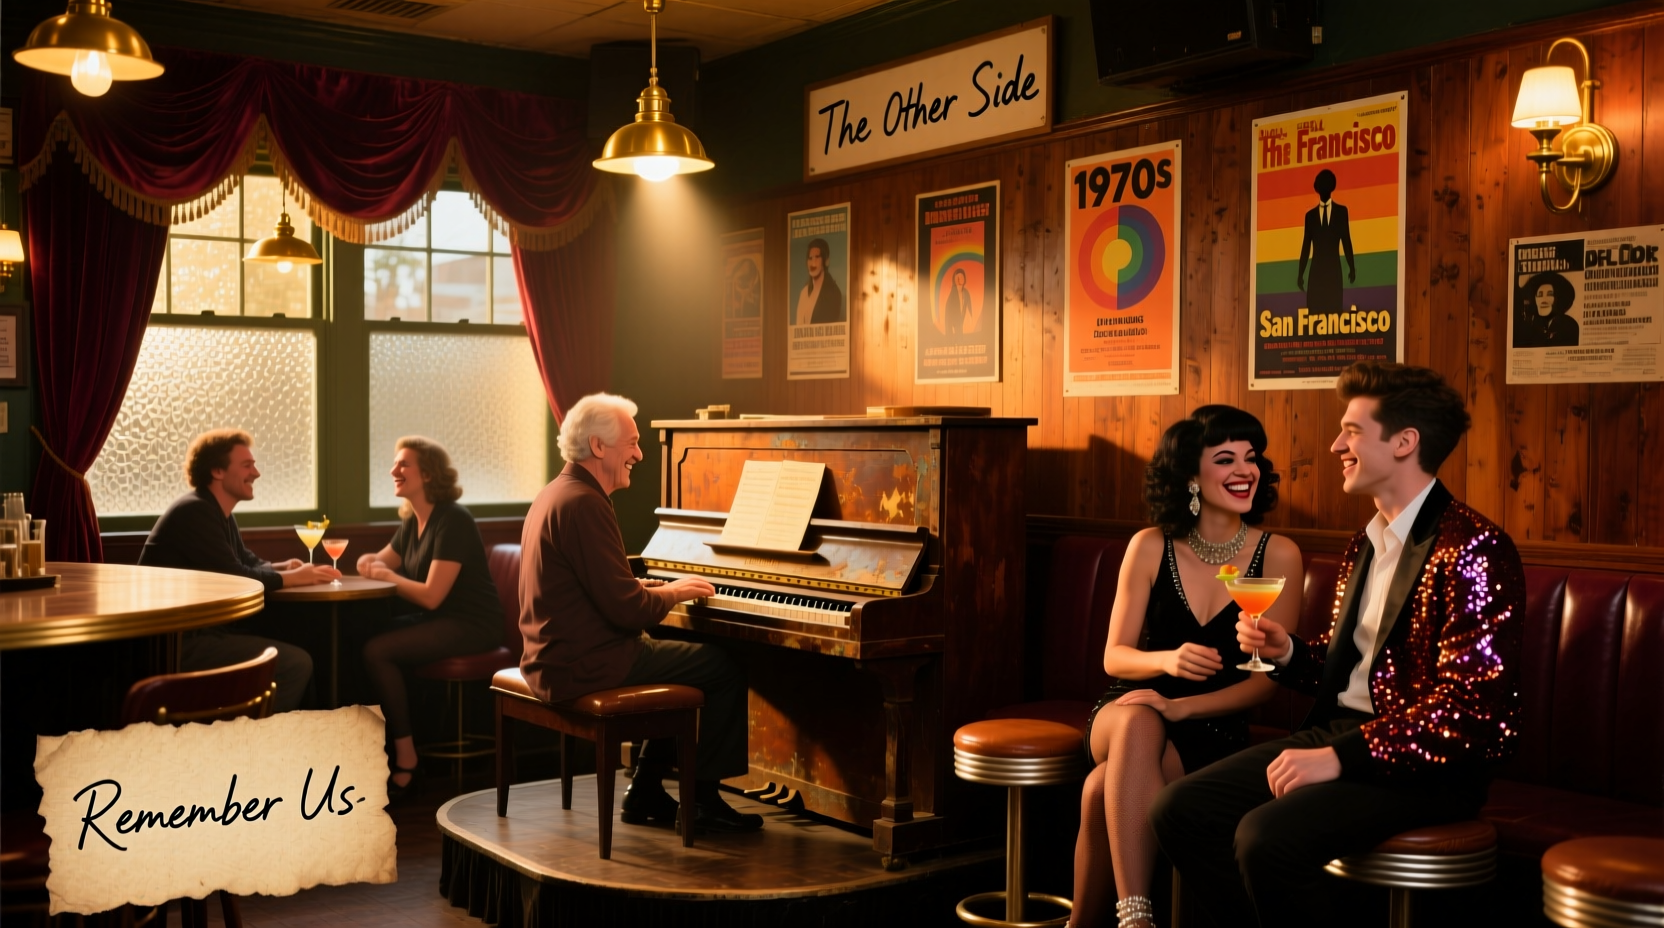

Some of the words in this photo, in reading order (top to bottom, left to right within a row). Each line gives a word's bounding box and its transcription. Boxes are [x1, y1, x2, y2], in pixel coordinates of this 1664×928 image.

[818, 99, 872, 156] The
[883, 81, 958, 137] Other
[968, 53, 1040, 118] Side
[1296, 121, 1396, 164] Francisco
[1074, 157, 1172, 210] 1970s
[1259, 309, 1294, 338] San
[1297, 304, 1391, 336] Francisco
[73, 773, 284, 852] Remember
